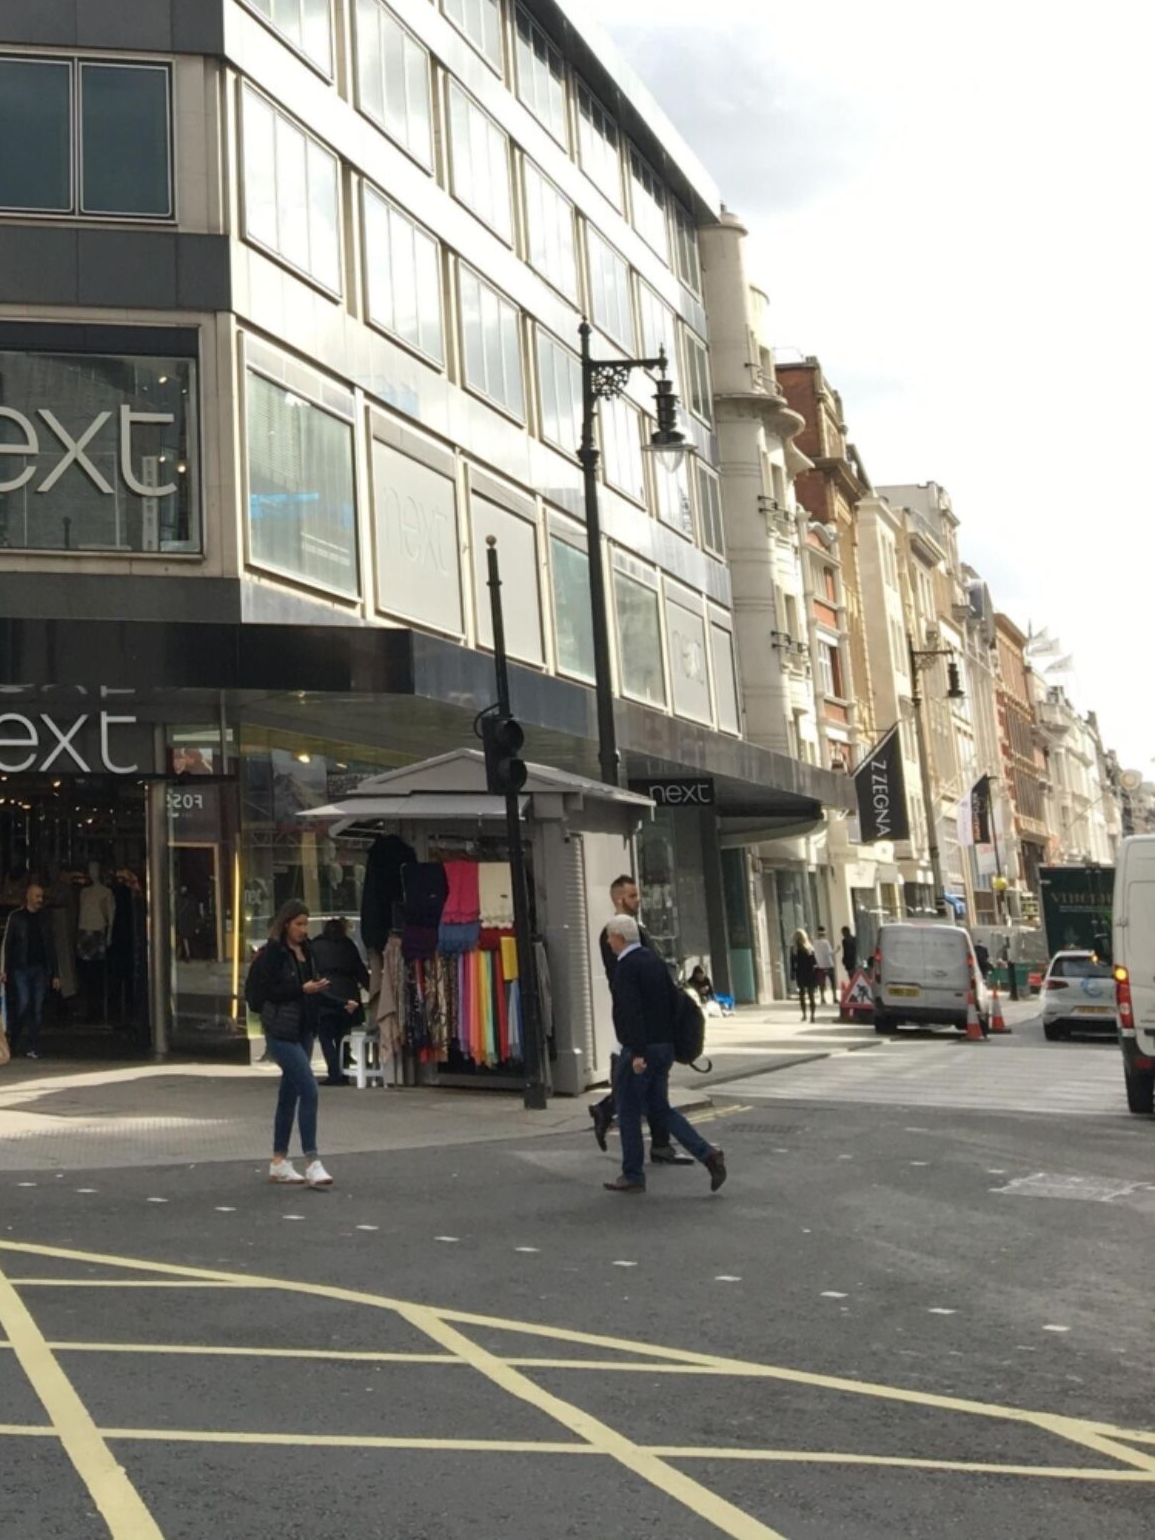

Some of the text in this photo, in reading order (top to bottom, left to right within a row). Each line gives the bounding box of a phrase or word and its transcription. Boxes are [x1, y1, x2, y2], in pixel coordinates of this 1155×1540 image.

[649, 783, 712, 804] next
[871, 760, 892, 837] Z ZEGNA
